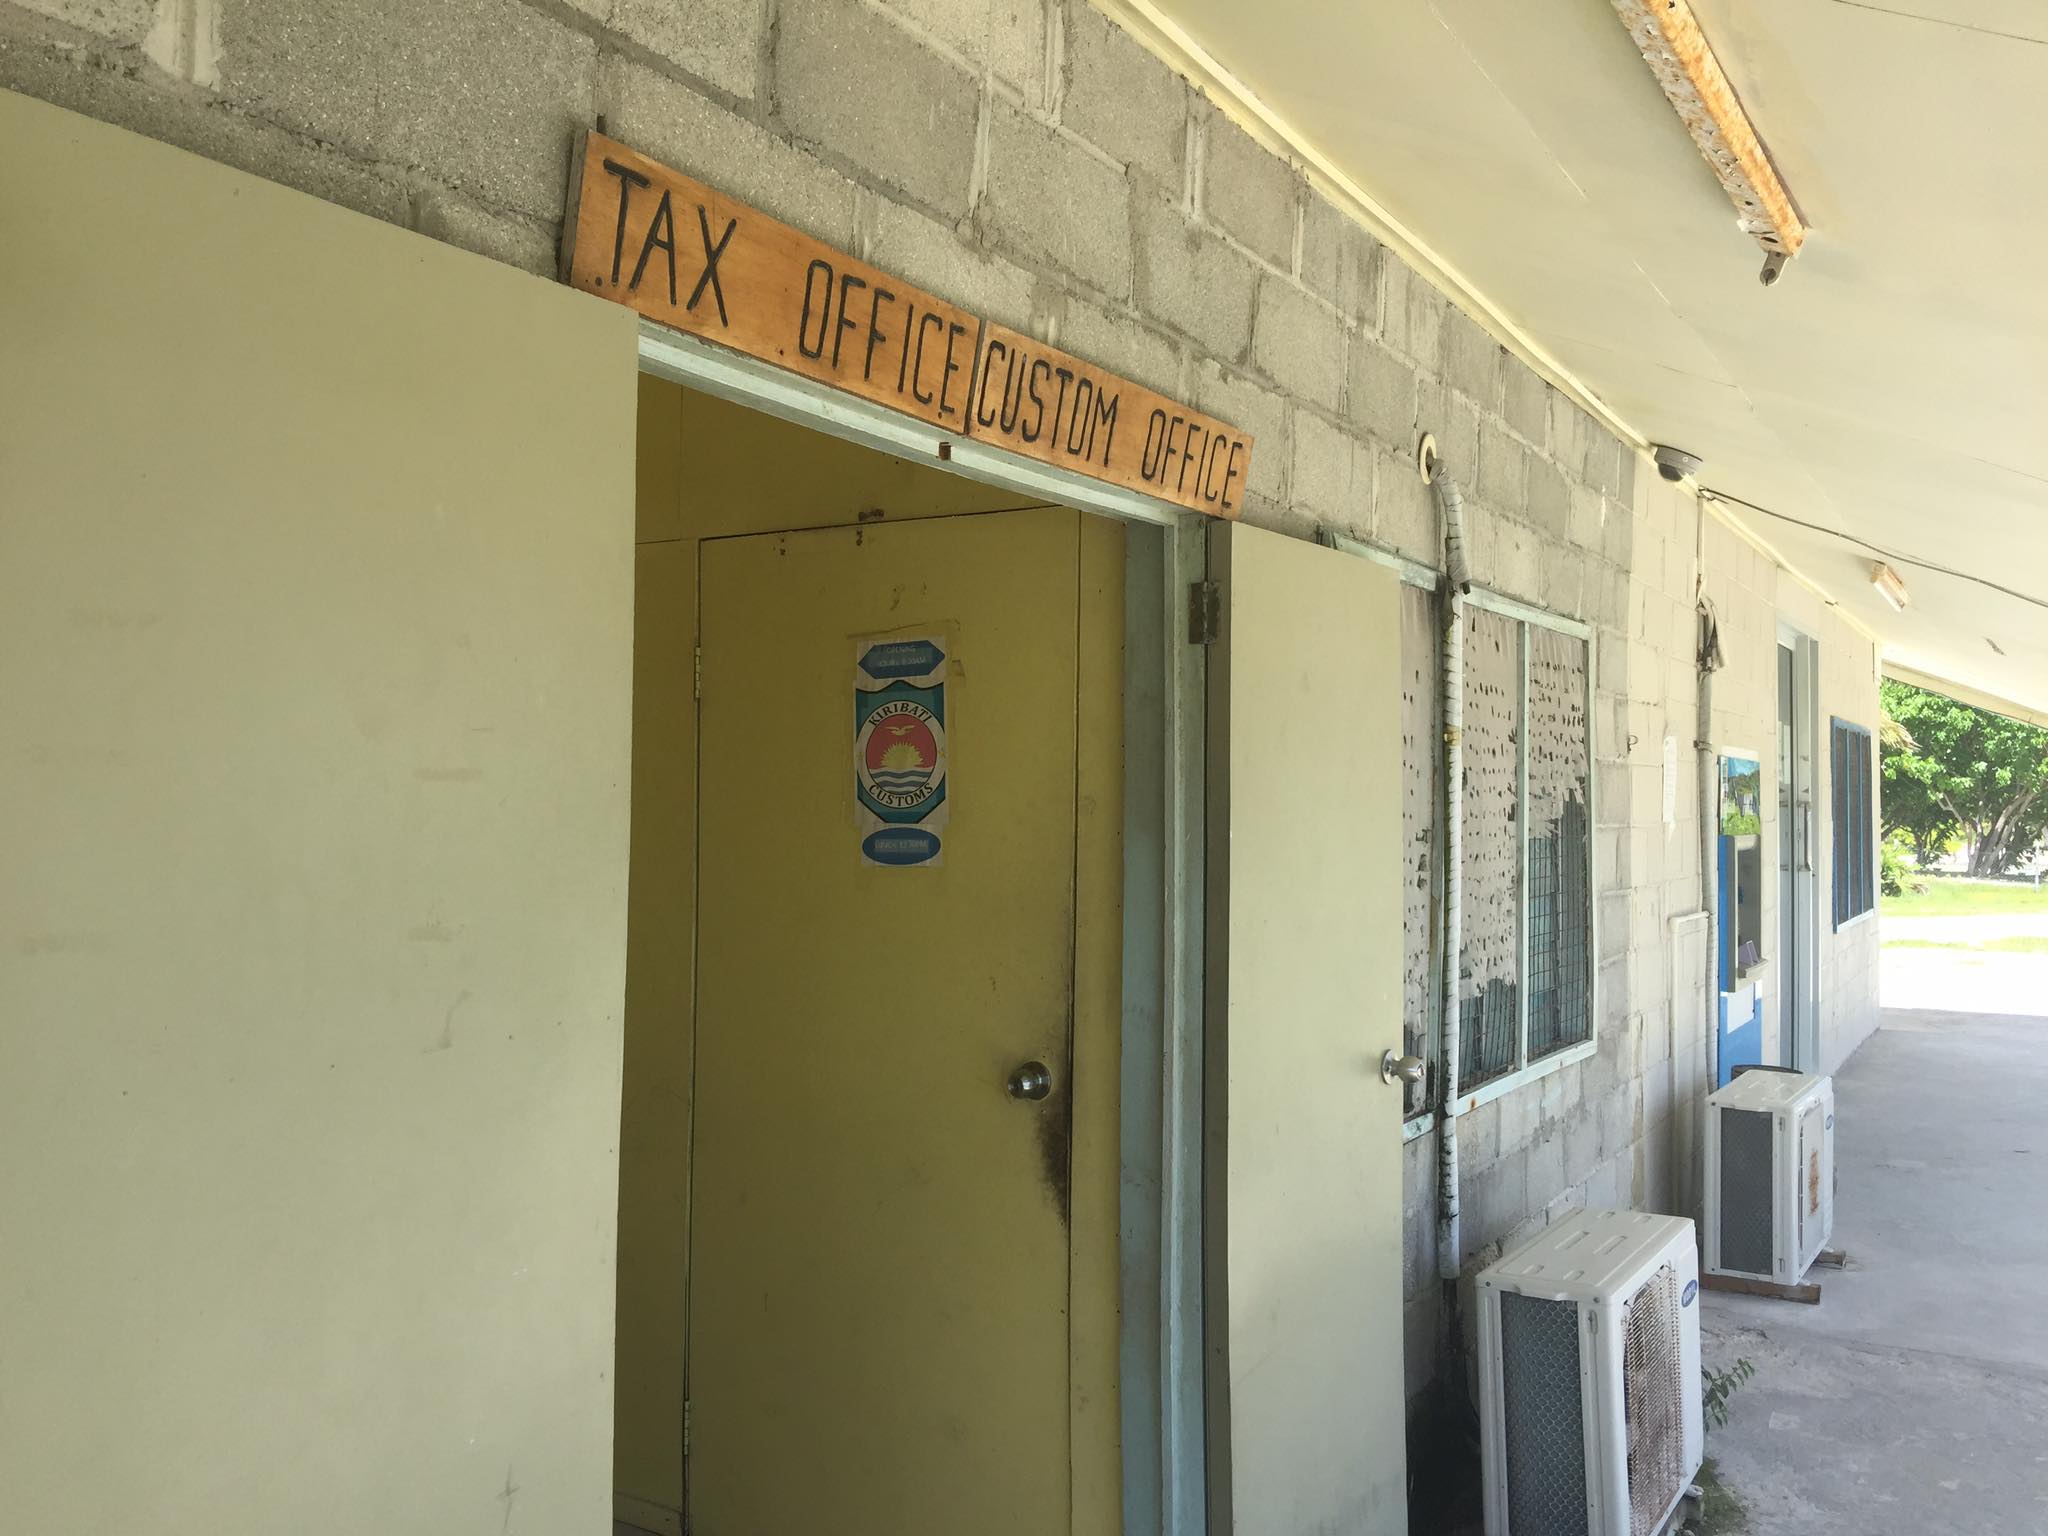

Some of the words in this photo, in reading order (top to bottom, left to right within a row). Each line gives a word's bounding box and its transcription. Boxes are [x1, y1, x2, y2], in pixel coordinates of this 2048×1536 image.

[603, 157, 738, 328] TAX
[798, 258, 968, 415] OFFICE
[976, 338, 1118, 467] CUSTOM
[1141, 407, 1244, 509] OFFICE
[868, 702, 933, 727] KIRIBATI
[868, 782, 934, 807] CUSTOMS
